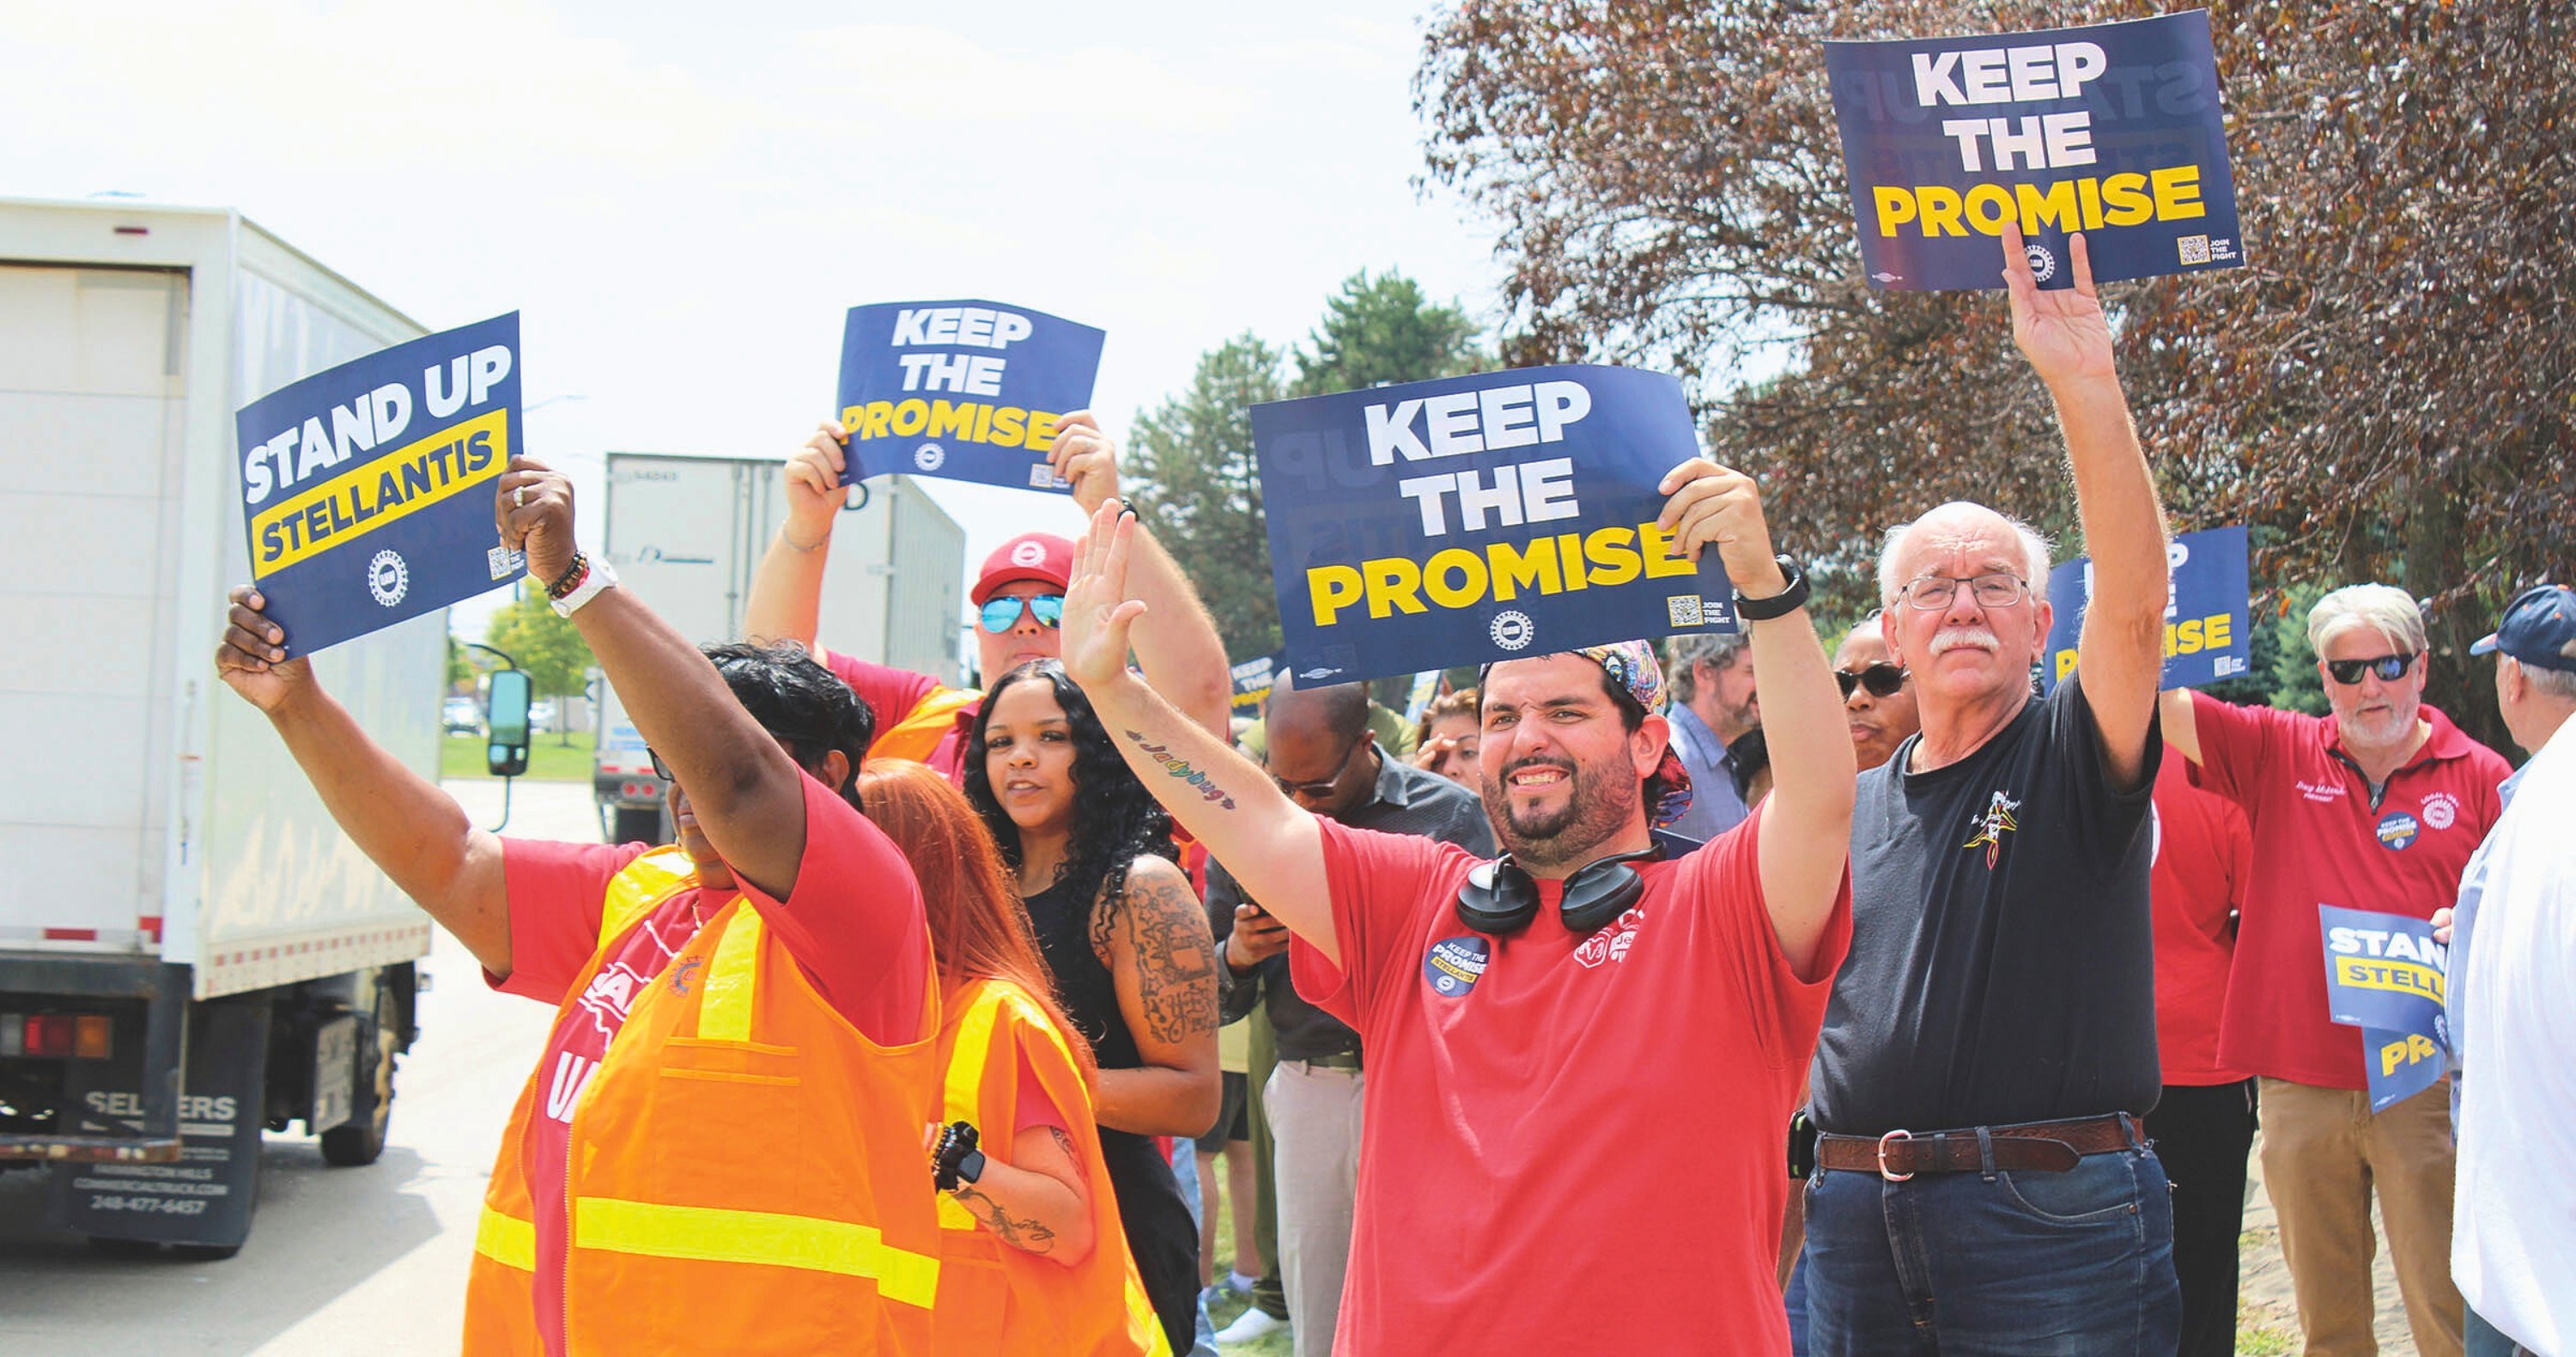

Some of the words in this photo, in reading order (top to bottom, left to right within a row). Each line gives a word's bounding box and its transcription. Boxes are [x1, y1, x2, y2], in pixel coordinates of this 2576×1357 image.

[1911, 41, 2107, 106] KEEP
[1942, 111, 2097, 172] THE
[1873, 164, 2206, 238] PROMISE
[2210, 239, 2230, 247] JOIN
[2210, 246, 2228, 254] THE
[2212, 252, 2237, 261] FIGHT
[891, 307, 1033, 350] KEEP
[899, 353, 1007, 397] THE
[245, 383, 413, 504] STAND
[424, 344, 513, 419] UP
[839, 398, 1063, 453] PROMISE
[1364, 380, 1592, 466] KEEP
[262, 429, 493, 563] STELLANTIS
[1398, 457, 1580, 538] THE
[1306, 520, 1698, 627] PROMISE
[1703, 601, 1723, 610] JOIN
[1704, 616, 1731, 624] FIGHT
[1432, 943, 1488, 976] PROMISE
[1447, 942, 1472, 958] KEEP
[1472, 952, 1486, 963] THE
[2329, 927, 2446, 974] STAN
[2348, 965, 2445, 996] STELL
